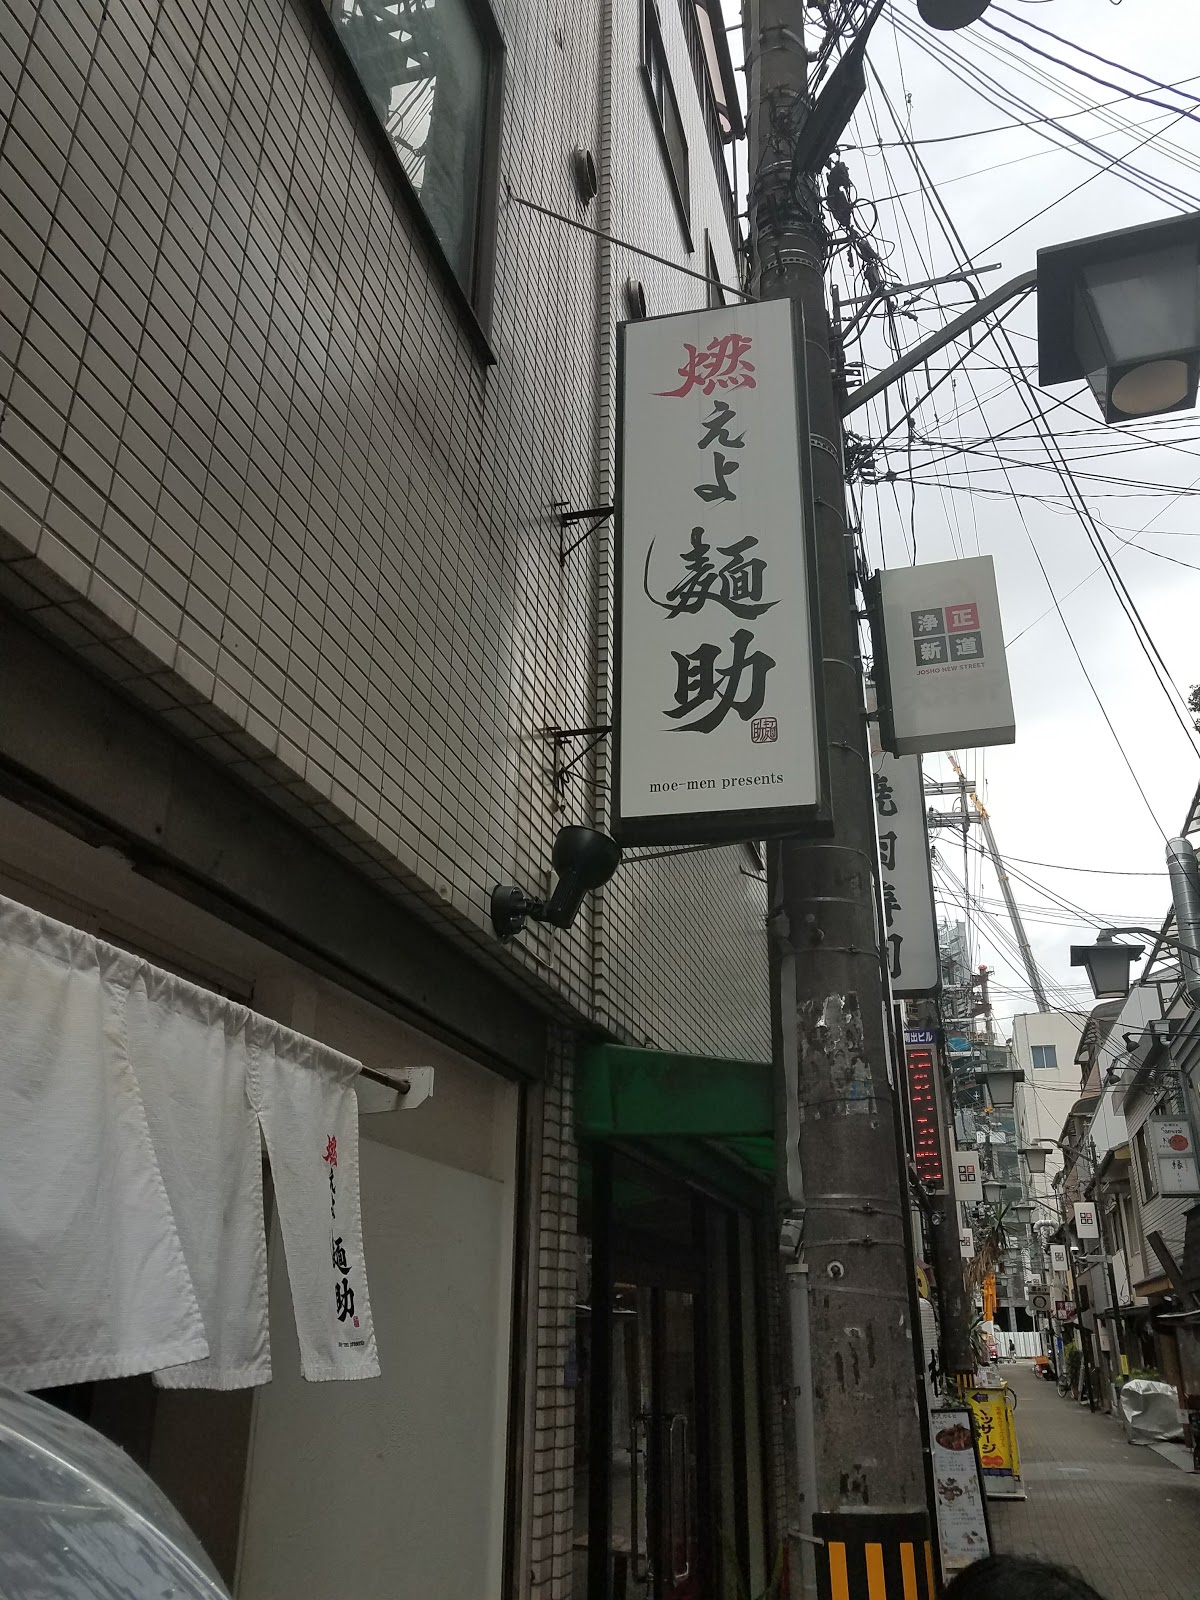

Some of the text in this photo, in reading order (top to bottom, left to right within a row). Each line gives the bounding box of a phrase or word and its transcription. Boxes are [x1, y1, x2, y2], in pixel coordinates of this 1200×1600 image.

[917, 662, 985, 676] JOSHO NEW STREET
[649, 772, 784, 793] moe-men presents
